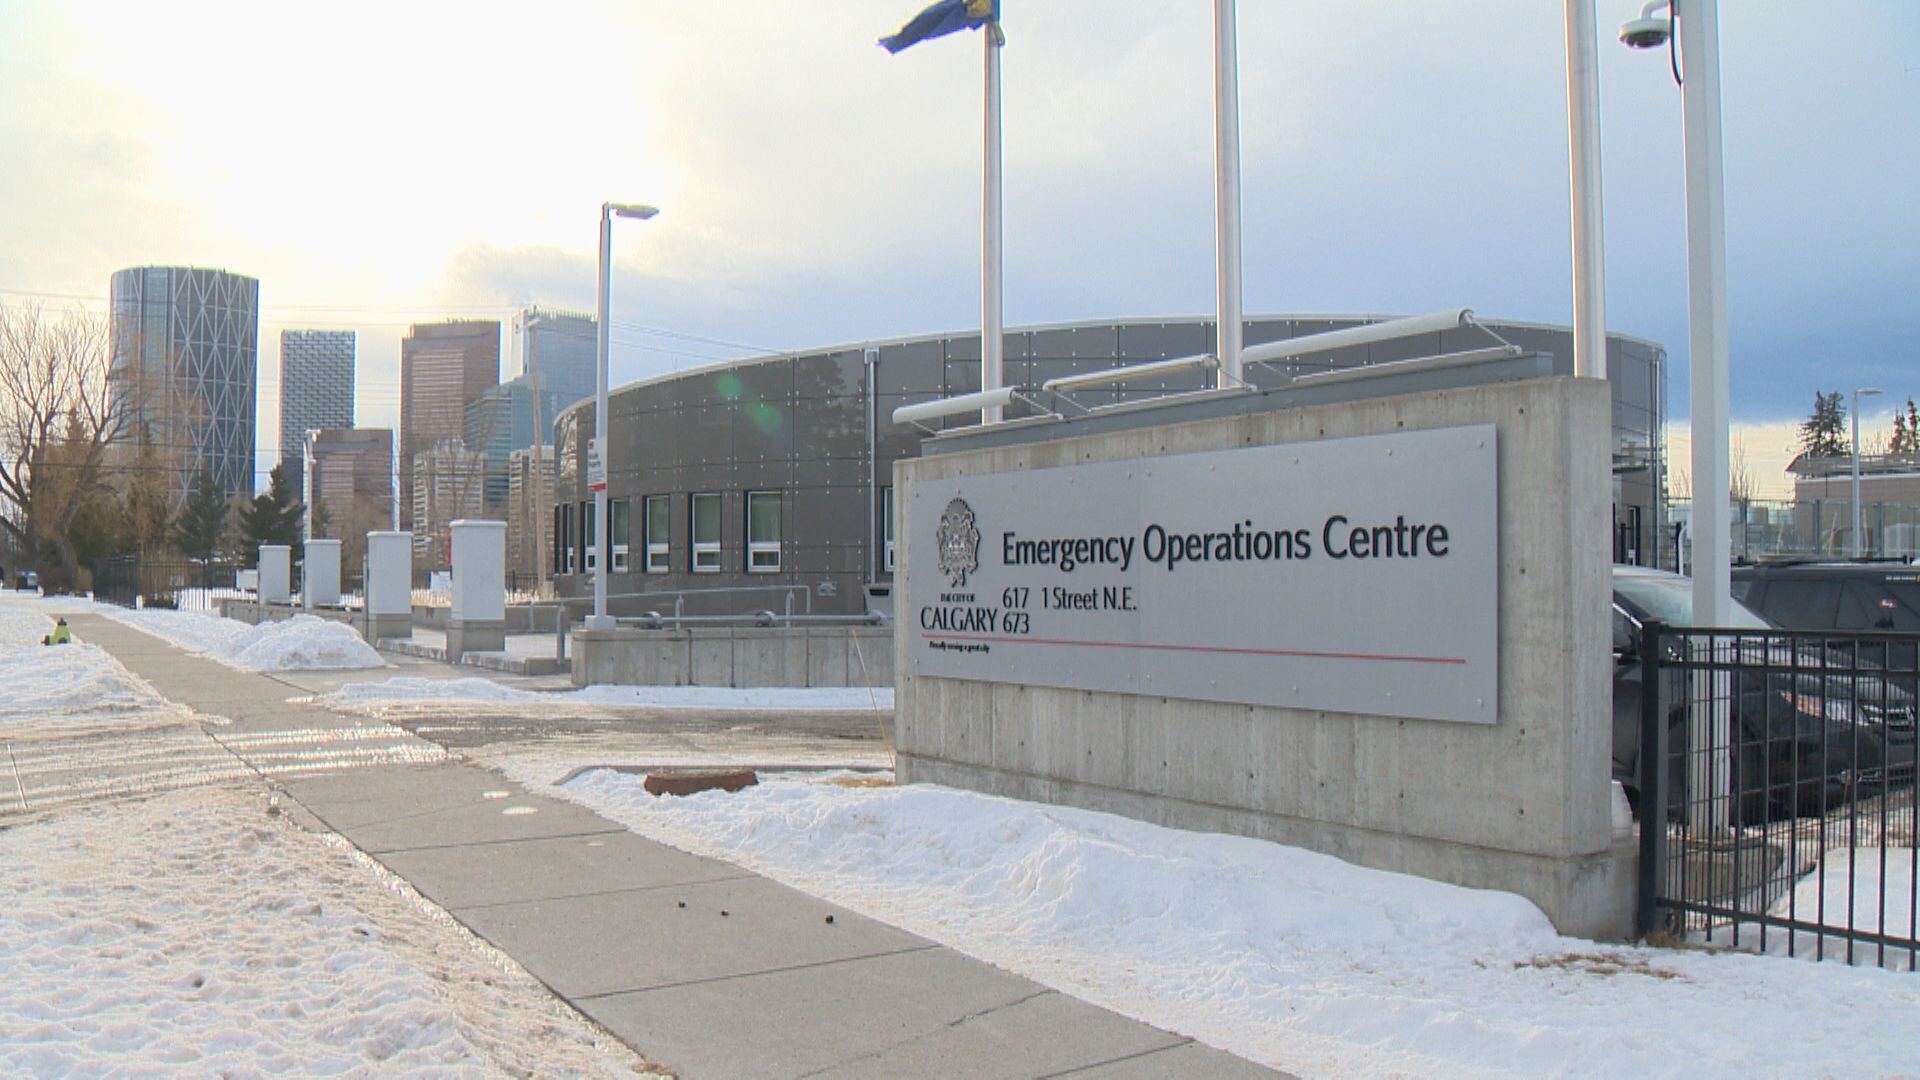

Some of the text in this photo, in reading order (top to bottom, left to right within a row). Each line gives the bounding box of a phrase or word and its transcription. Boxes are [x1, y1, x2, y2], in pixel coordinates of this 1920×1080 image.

[1003, 515, 1449, 572] Emergency Operations Centre
[1002, 586, 1137, 610] 617 1 Street N.E.
[920, 606, 998, 632] CALGARY
[1002, 612, 1030, 634] 673
